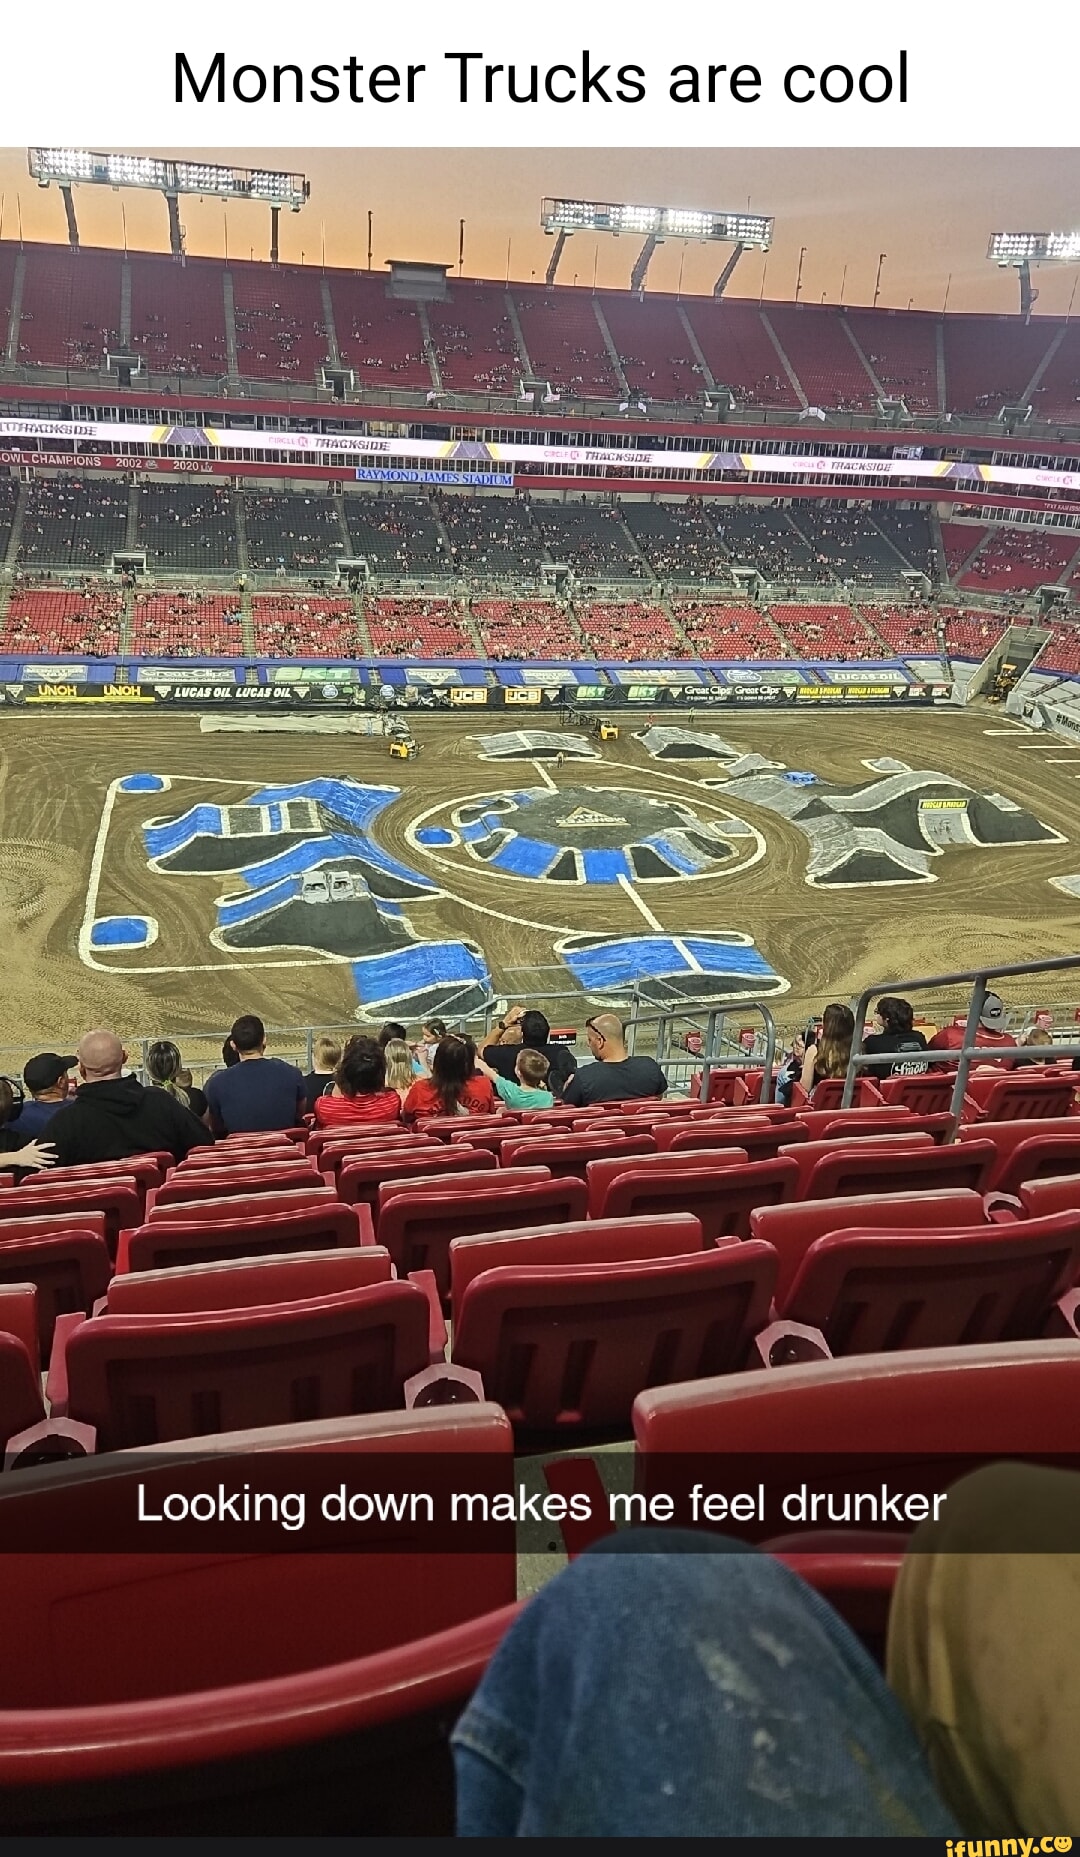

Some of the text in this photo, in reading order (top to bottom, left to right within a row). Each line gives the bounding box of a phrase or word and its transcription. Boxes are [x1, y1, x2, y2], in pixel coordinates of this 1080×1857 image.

[0, 452, 29, 464] OWL
[31, 453, 102, 467] CHAMPIONS
[115, 458, 143, 468] 2002
[173, 461, 199, 471] 2020
[357, 468, 513, 486] RAYMOND JAMES STADIUM
[834, 672, 876, 681] LUCAS
[38, 684, 77, 696] UNOH
[103, 684, 141, 696] UNOH
[174, 687, 212, 698] LUCAS
[213, 687, 233, 698] OIL
[235, 687, 272, 698] LUCAS
[273, 687, 292, 698] OIL
[453, 690, 485, 701] JCB
[508, 690, 539, 701] JCB
[576, 685, 607, 698] BKT
[684, 686, 709, 695] Great
[710, 686, 733, 696] Clips
[735, 686, 759, 695] Great
[760, 686, 781, 696] Clips
